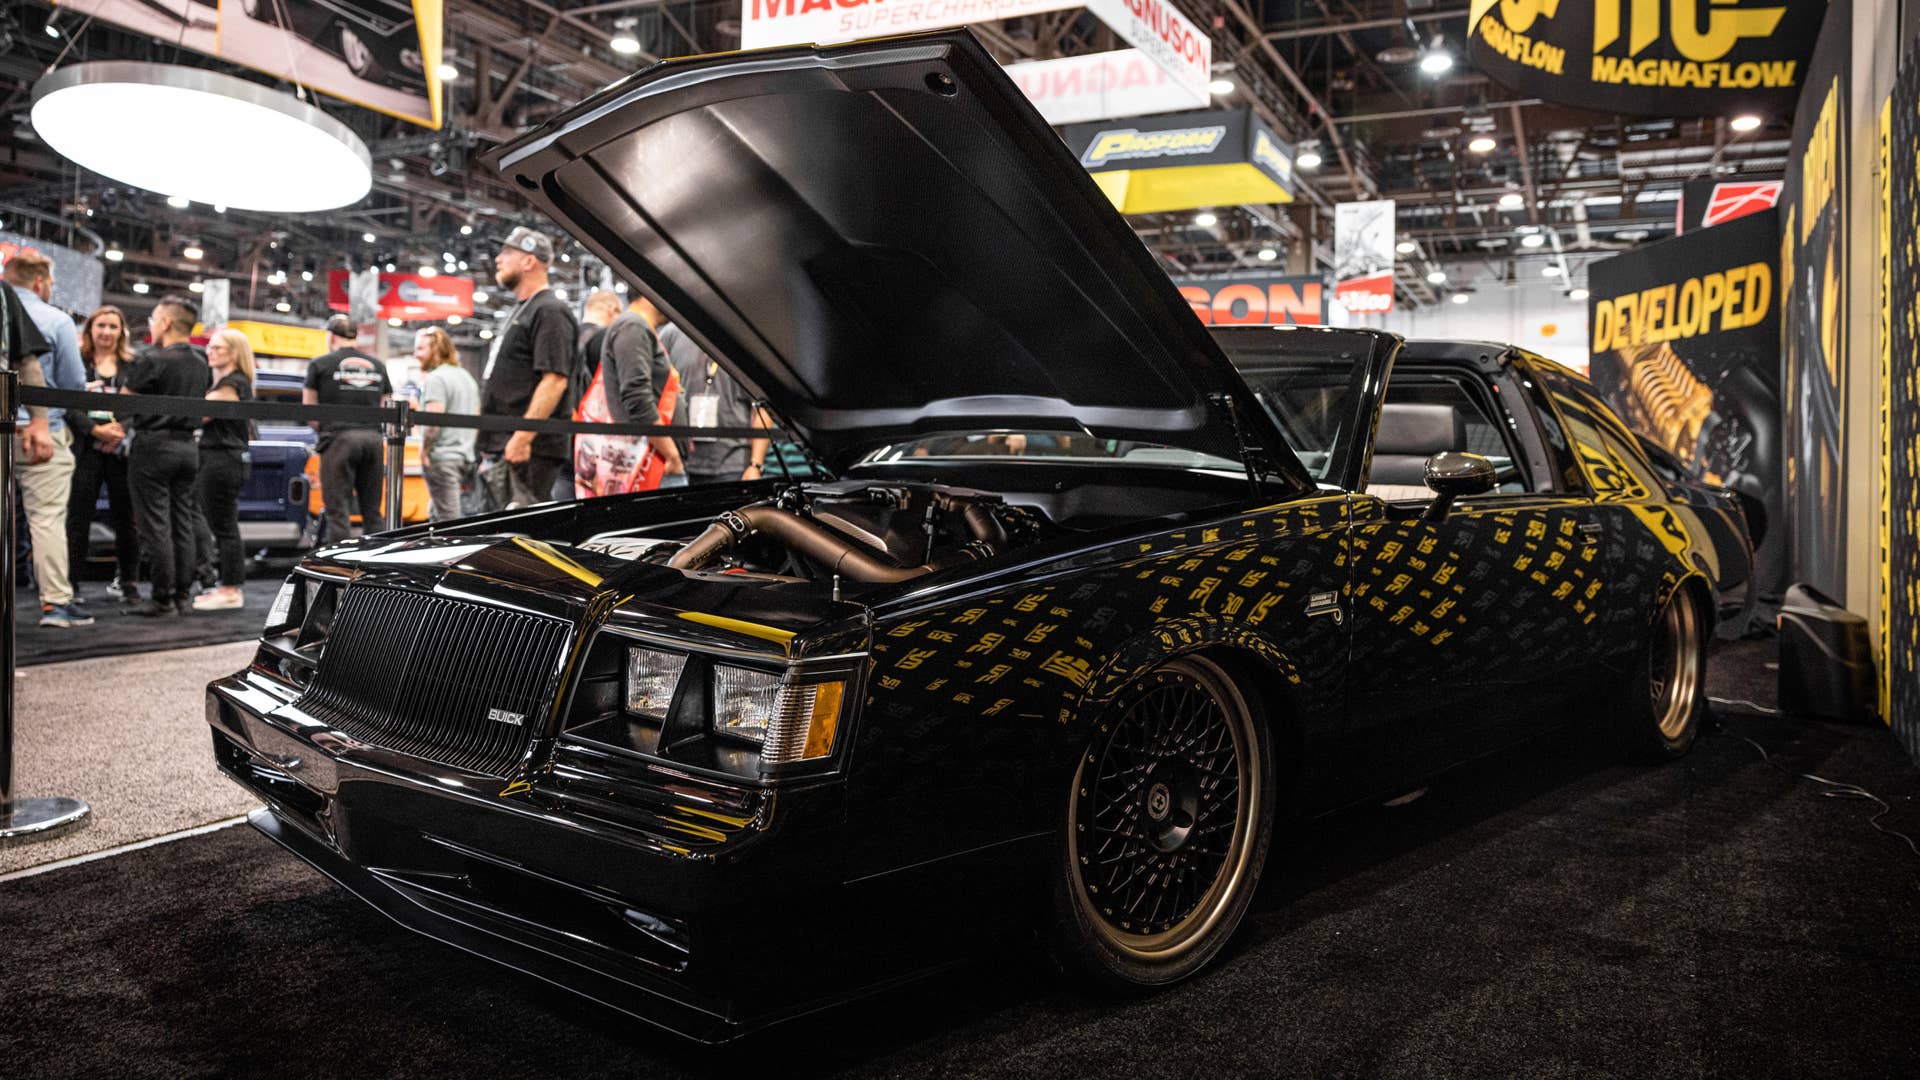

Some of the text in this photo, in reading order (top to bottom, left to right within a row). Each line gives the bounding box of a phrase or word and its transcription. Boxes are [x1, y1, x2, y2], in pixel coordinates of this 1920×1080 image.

[1592, 55, 1796, 88] MAGNAFLOW
[1593, 262, 1772, 354] DEVELOPED
[488, 708, 525, 726] BUICK
